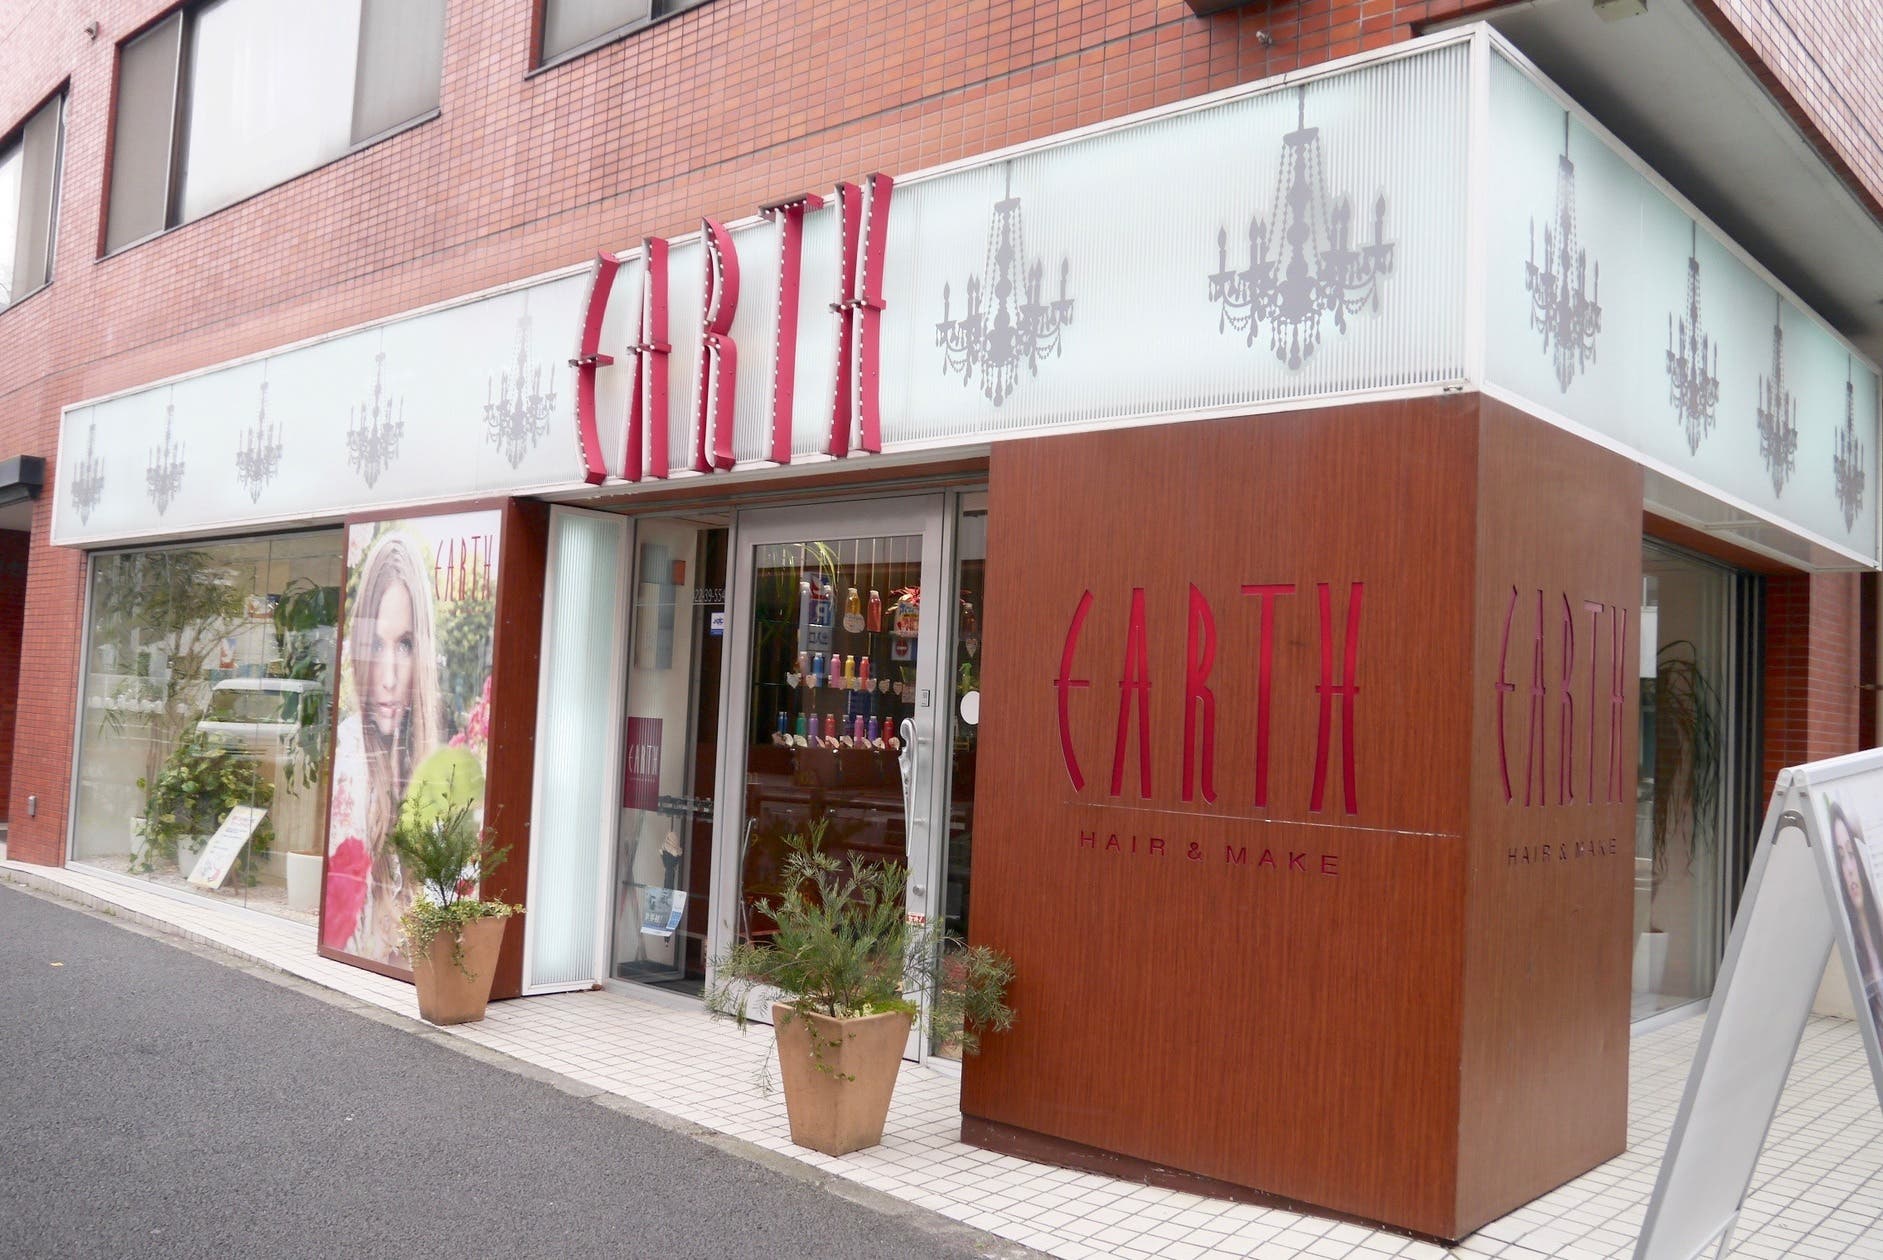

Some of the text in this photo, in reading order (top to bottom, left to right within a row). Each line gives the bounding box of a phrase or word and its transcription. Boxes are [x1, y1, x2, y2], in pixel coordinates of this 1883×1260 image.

[568, 172, 893, 486] EARTH
[434, 534, 493, 601] EARTH
[1053, 582, 1364, 815] EARTH
[1495, 584, 1627, 806] EARTH
[627, 744, 660, 775] EARTH
[1080, 830, 1339, 875] HAIR & MAKE
[1507, 845, 1552, 864] HAIR
[1575, 838, 1617, 859] MAKE
